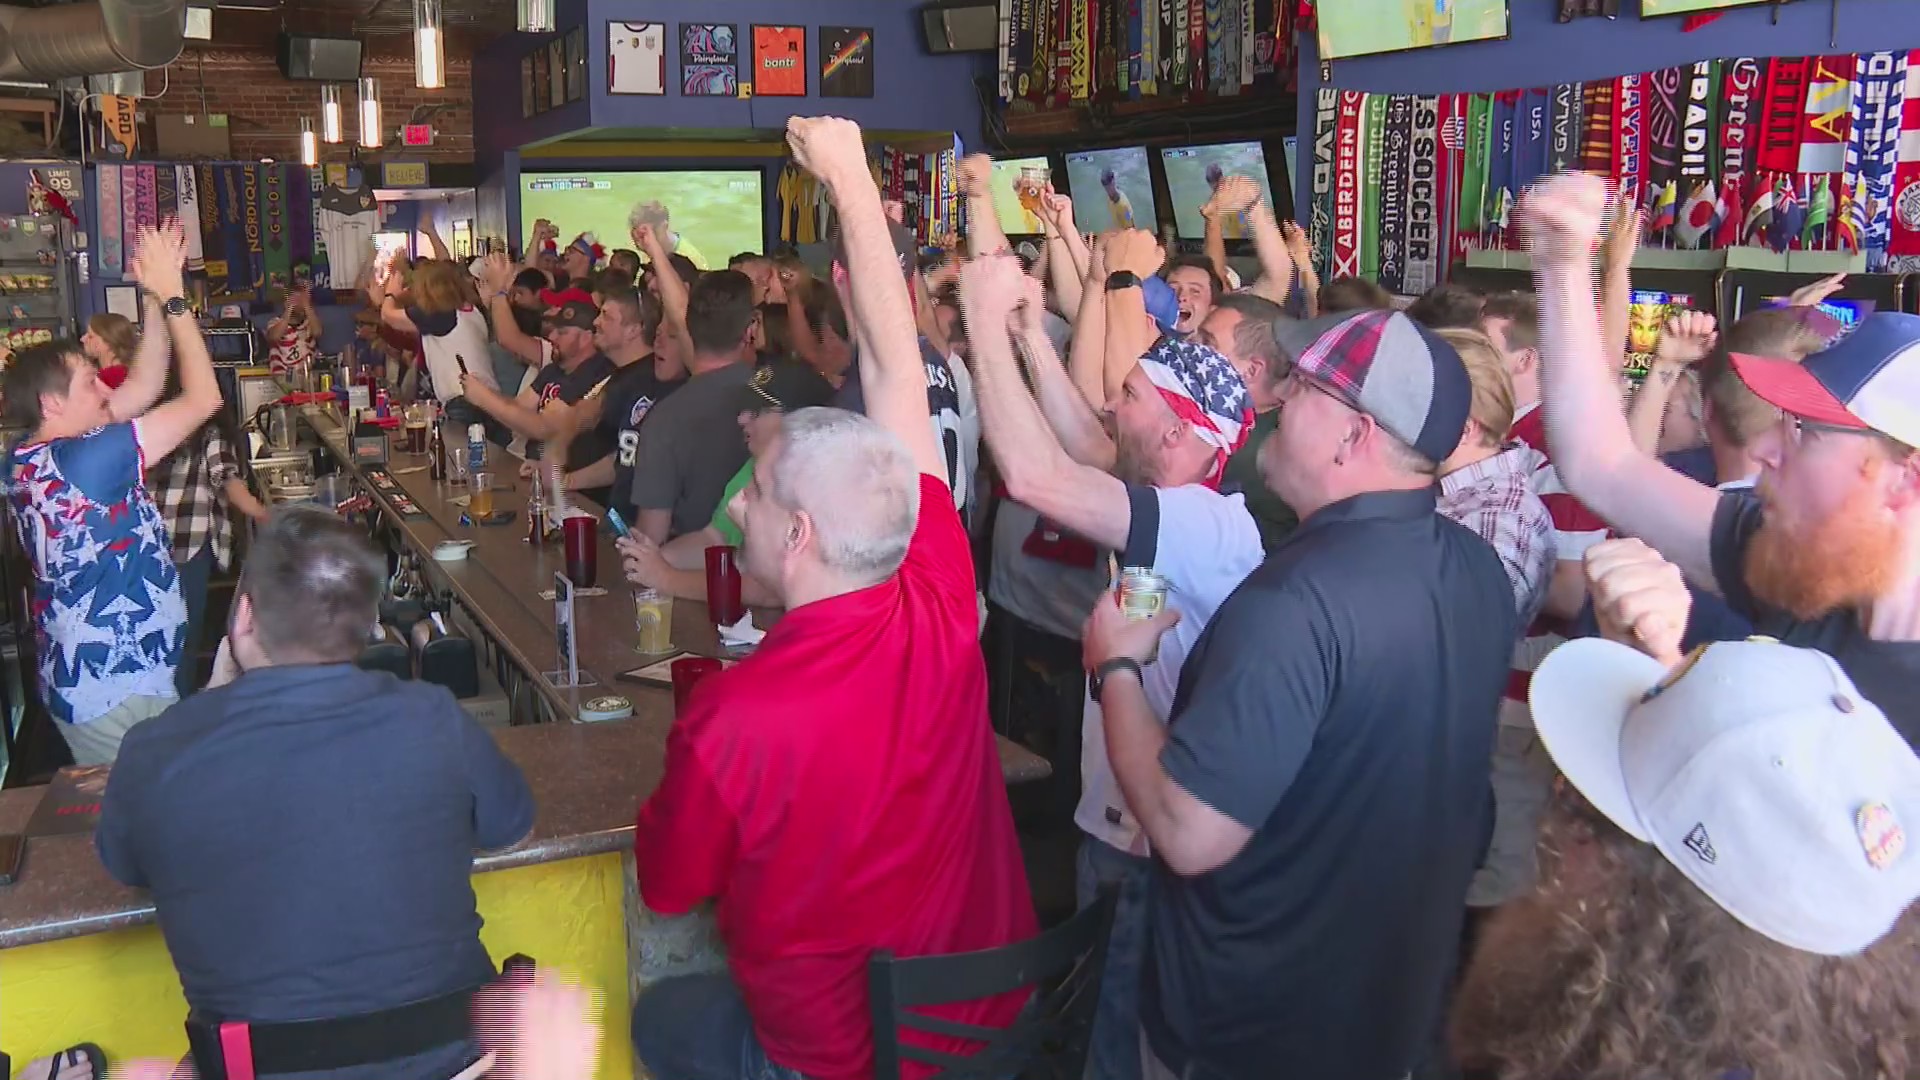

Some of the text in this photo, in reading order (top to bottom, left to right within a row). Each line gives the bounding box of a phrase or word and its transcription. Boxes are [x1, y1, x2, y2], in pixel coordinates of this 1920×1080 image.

[692, 53, 729, 64] Dairyland
[763, 56, 797, 69] bantr
[829, 54, 865, 65] Dairyland
[1868, 53, 1893, 76] D
[1502, 119, 1512, 153] USA
[1531, 106, 1543, 141] USA
[1368, 100, 1387, 185] CELTIC FC
[50, 178, 72, 190] 99
[137, 168, 147, 225] ORWA
[1337, 128, 1355, 249] ABERDEEN
[1384, 130, 1404, 233] Greenville
[244, 165, 262, 252] NORDIQUE
[1409, 137, 1435, 262] SOCCER
